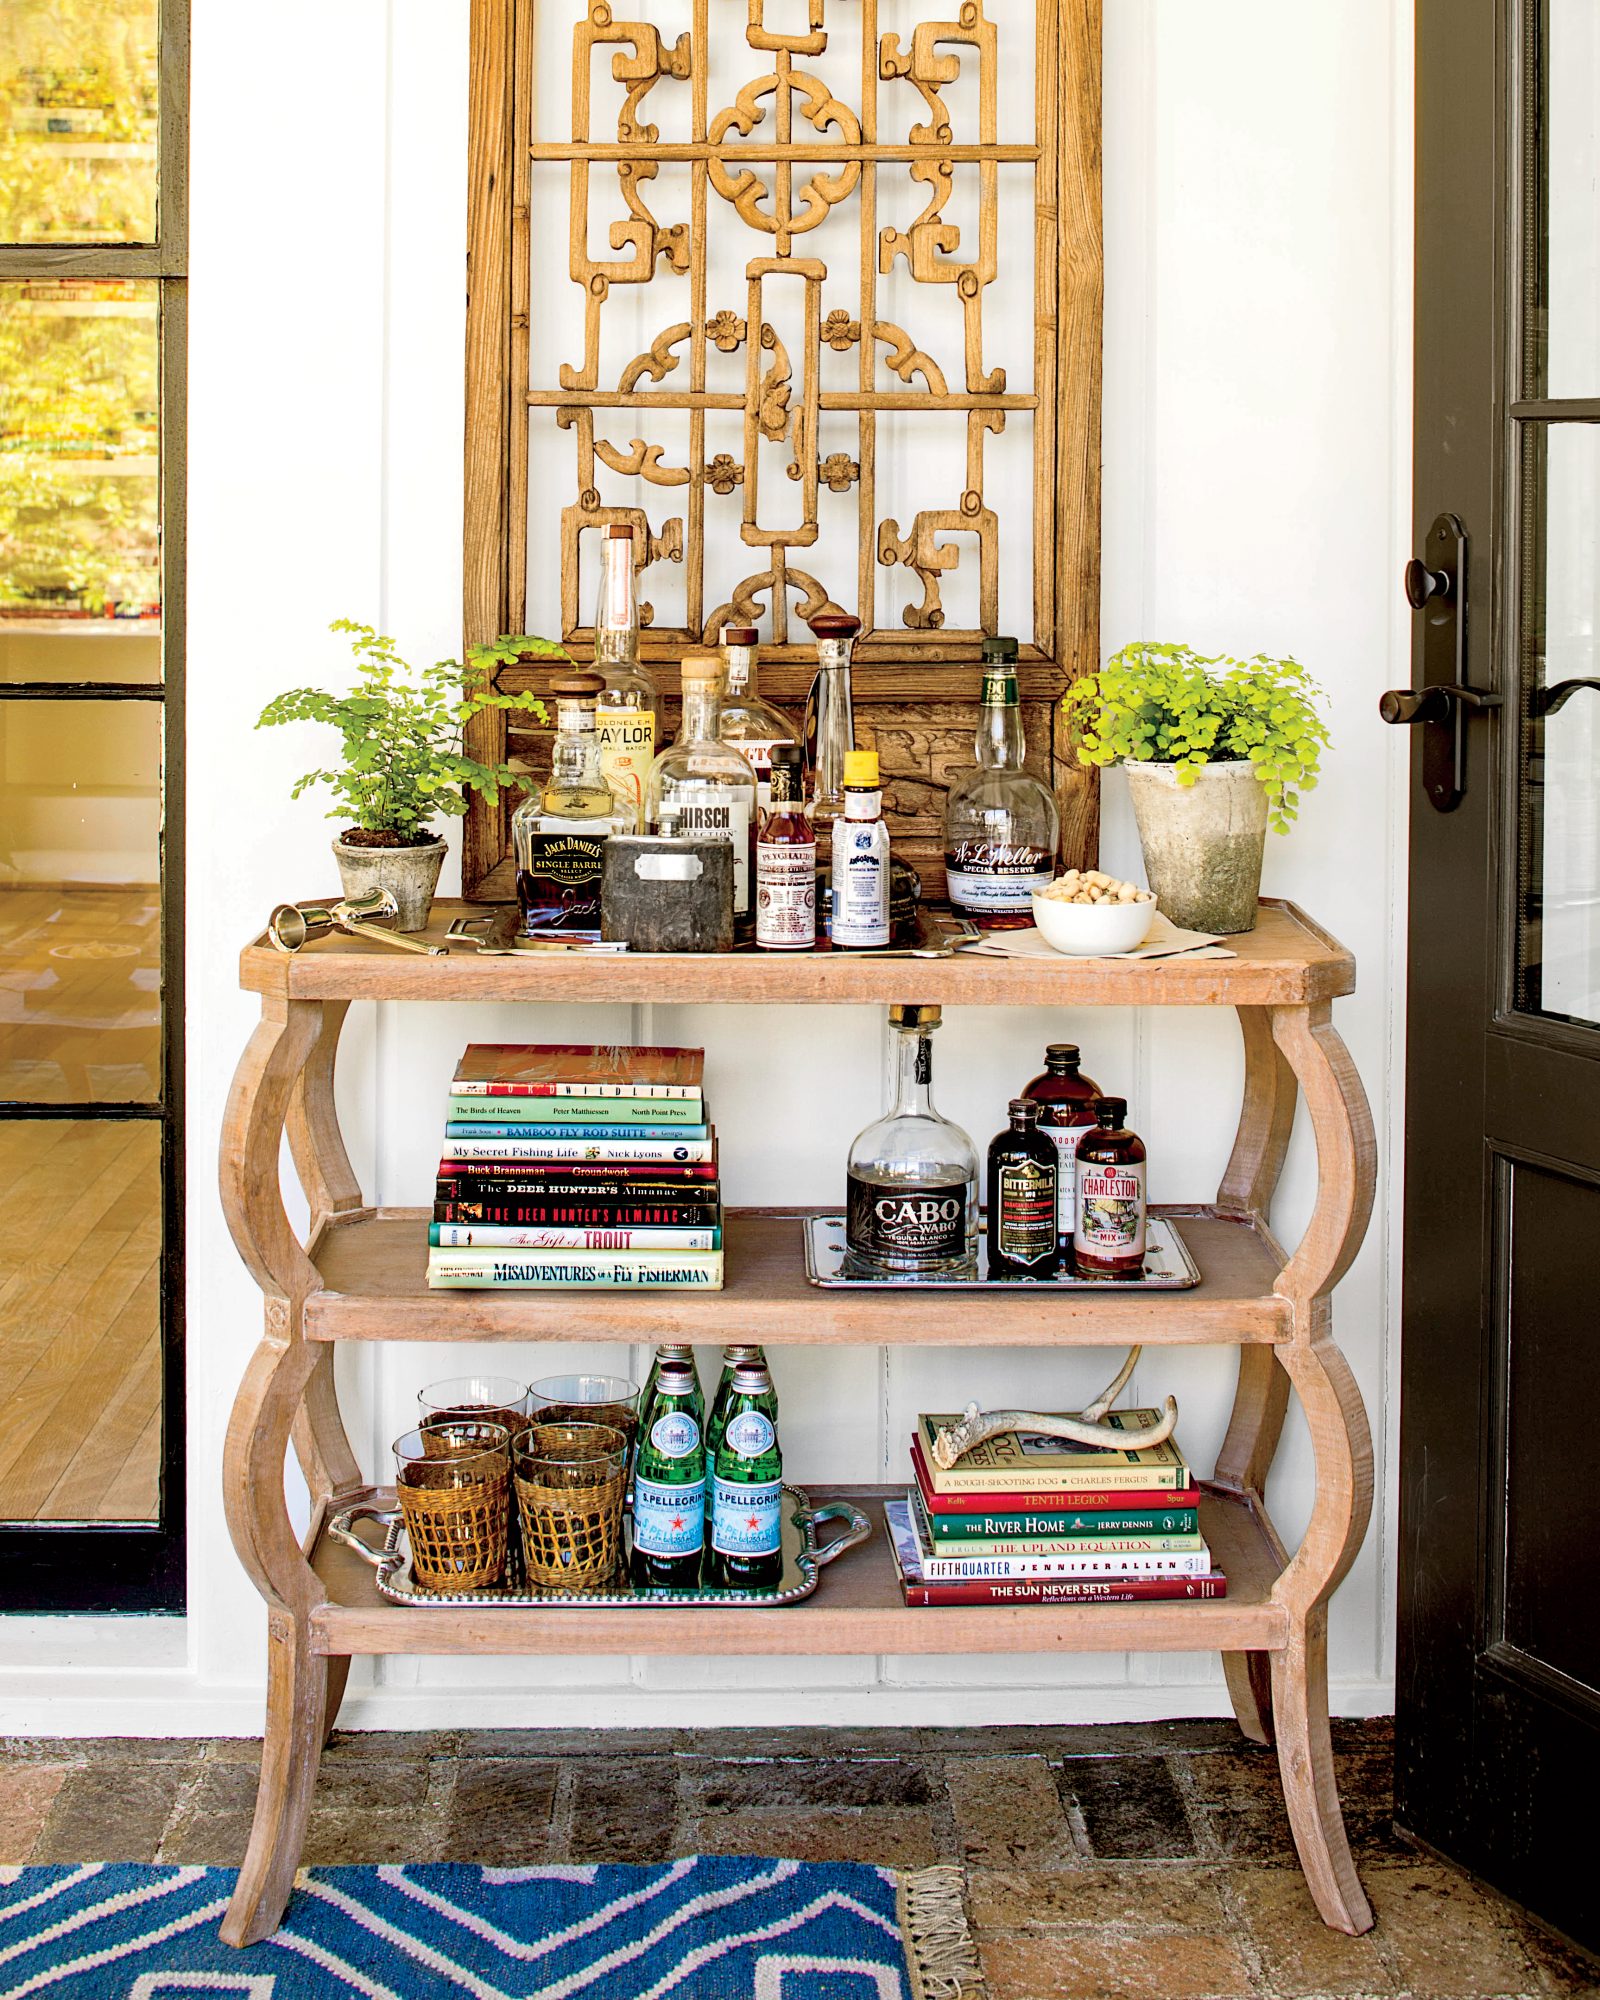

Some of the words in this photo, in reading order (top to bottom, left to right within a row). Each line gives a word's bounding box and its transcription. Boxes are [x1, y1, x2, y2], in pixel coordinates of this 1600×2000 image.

[987, 680, 1006, 695] 90
[680, 807, 730, 829] HIRSCH
[544, 838, 567, 857] JACK
[567, 836, 601, 858] DANIEL'S
[989, 843, 1043, 867] Weller
[536, 860, 570, 869] SINGLE
[572, 860, 602, 869] BARRE
[963, 865, 995, 874] SPECIAL
[997, 866, 1035, 874] RESERVE
[456, 1106, 468, 1114] The
[470, 1106, 487, 1114] Birds
[488, 1106, 496, 1114] of
[497, 1107, 521, 1115] Heaven
[553, 1107, 569, 1115] Peter
[571, 1107, 609, 1115] Matthiessen
[631, 1108, 651, 1116] North
[652, 1108, 668, 1116] Point
[506, 1128, 557, 1137] BAMBOO
[559, 1128, 580, 1137] FLY
[582, 1128, 608, 1137] ROD
[611, 1129, 647, 1138] SUITE
[661, 1130, 683, 1138] Georgia
[453, 1147, 469, 1157] My
[472, 1147, 508, 1157] Secret
[512, 1147, 553, 1158] Fishing
[556, 1147, 578, 1157] Life
[607, 1150, 630, 1158] Nick
[633, 1150, 663, 1159] Lyons
[467, 1165, 490, 1175] Buck
[493, 1165, 545, 1176] Brannaman
[572, 1166, 630, 1177] Groundwork
[1003, 1176, 1054, 1190] BITTERMILK
[1083, 1178, 1137, 1197] CHARLESTON
[478, 1184, 501, 1193] The
[506, 1185, 545, 1193] DEER
[548, 1186, 618, 1194] HUNTER'S
[622, 1186, 678, 1196] Almanac
[486, 1207, 509, 1221] THE
[517, 1207, 546, 1222] DEER
[553, 1208, 609, 1222] HUNTER'S
[616, 1209, 679, 1223] ALMANAC
[874, 1199, 960, 1225] CABO
[919, 1220, 956, 1234] WABO
[532, 1229, 564, 1248] Gift
[567, 1236, 583, 1248] of
[584, 1231, 633, 1249] TROUT
[1100, 1233, 1117, 1241] MIX
[493, 1263, 596, 1282] MISADVENTURES
[613, 1264, 633, 1283] FLY
[638, 1265, 709, 1283] FISHERMAN
[954, 1478, 1035, 1487] ROUGH-SHOOTING
[1070, 1477, 1112, 1485] CHARLES
[1114, 1476, 1148, 1484] FERGUS
[947, 1497, 966, 1506] Kelly
[1023, 1495, 1064, 1505] TENTH
[1068, 1494, 1109, 1504] LEGION
[1167, 1494, 1184, 1503] Spur
[965, 1524, 982, 1532] THE
[984, 1518, 1022, 1534] RIVER
[1025, 1517, 1065, 1533] HOME
[1097, 1521, 1121, 1530] JERRY
[1122, 1520, 1153, 1529] DENNIS
[991, 1544, 1019, 1553] THE
[1022, 1542, 1075, 1553] UPLAND
[1080, 1540, 1151, 1552] EQUATION
[930, 1561, 1010, 1576] FIFTHQUARTER
[1020, 1562, 1112, 1571] JENNIFER
[1121, 1561, 1177, 1570] ALLEN
[990, 1586, 1014, 1597] THE
[1014, 1585, 1040, 1596] SUN
[1042, 1584, 1080, 1596] NEVER
[1083, 1583, 1110, 1594] SETS
[1041, 1595, 1077, 1603] Reflections
[1120, 1593, 1134, 1601] Life
